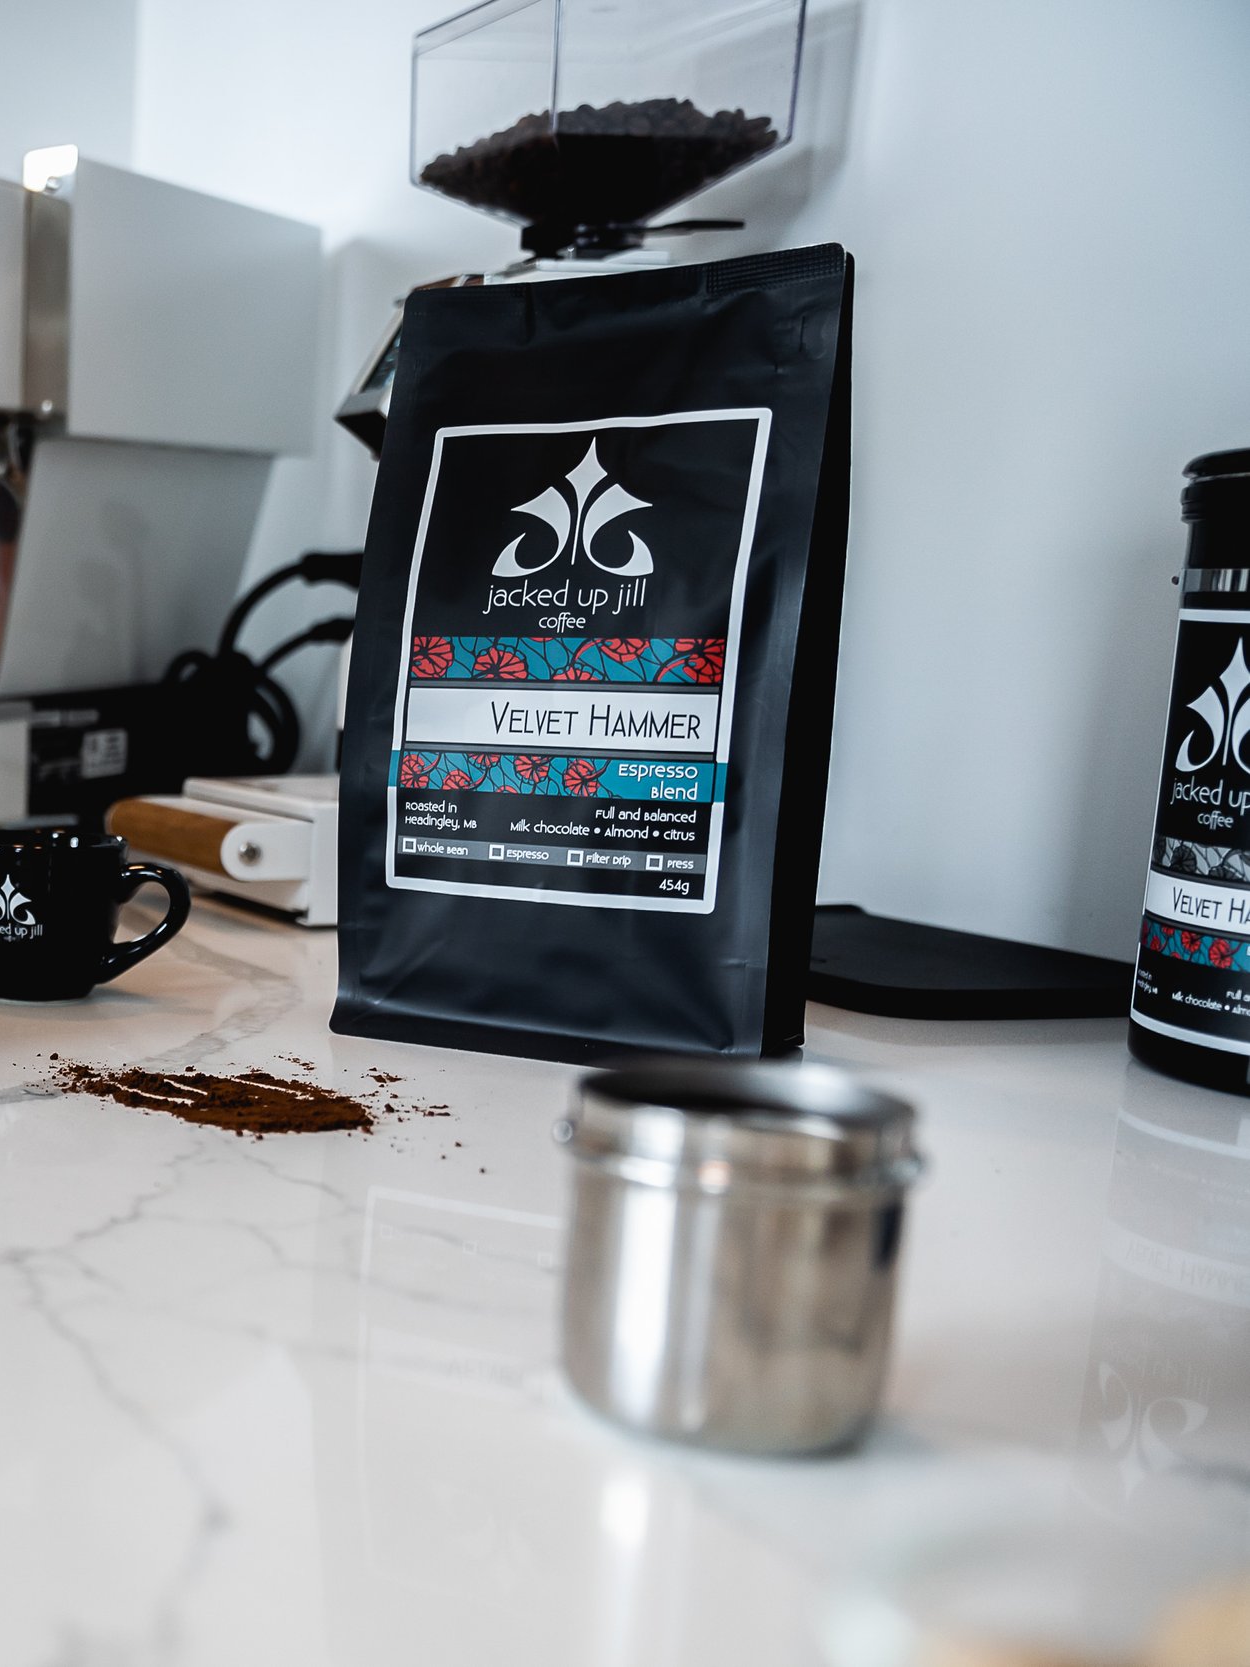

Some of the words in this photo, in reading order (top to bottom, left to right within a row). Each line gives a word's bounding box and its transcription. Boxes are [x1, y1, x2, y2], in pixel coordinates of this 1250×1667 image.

[482, 579, 570, 615] jacked
[577, 588, 609, 615] up
[612, 578, 647, 615] jill
[538, 612, 586, 633] coffee
[491, 701, 579, 736] VELVET
[589, 704, 700, 739] HAMMER
[618, 763, 698, 782] Espresso
[651, 780, 699, 801] Blend
[1169, 775, 1224, 805] jacked
[405, 800, 446, 813] Roasted
[448, 802, 458, 814] in
[595, 806, 615, 819] Full
[618, 807, 641, 821] and
[644, 808, 697, 824] Balanced
[405, 813, 461, 831] Headingley,
[463, 819, 478, 829] MB
[1197, 810, 1234, 830] coffee
[510, 819, 530, 832] Milk
[533, 820, 590, 836] chocolate
[604, 824, 649, 839] Almond
[663, 829, 696, 841] citrus
[506, 849, 549, 861] Espresso
[585, 851, 610, 865] Filter
[612, 855, 632, 868] Drip
[658, 878, 690, 895] 454g
[1173, 886, 1223, 920] VELVET
[14, 927, 28, 939] up
[29, 924, 43, 940] jill
